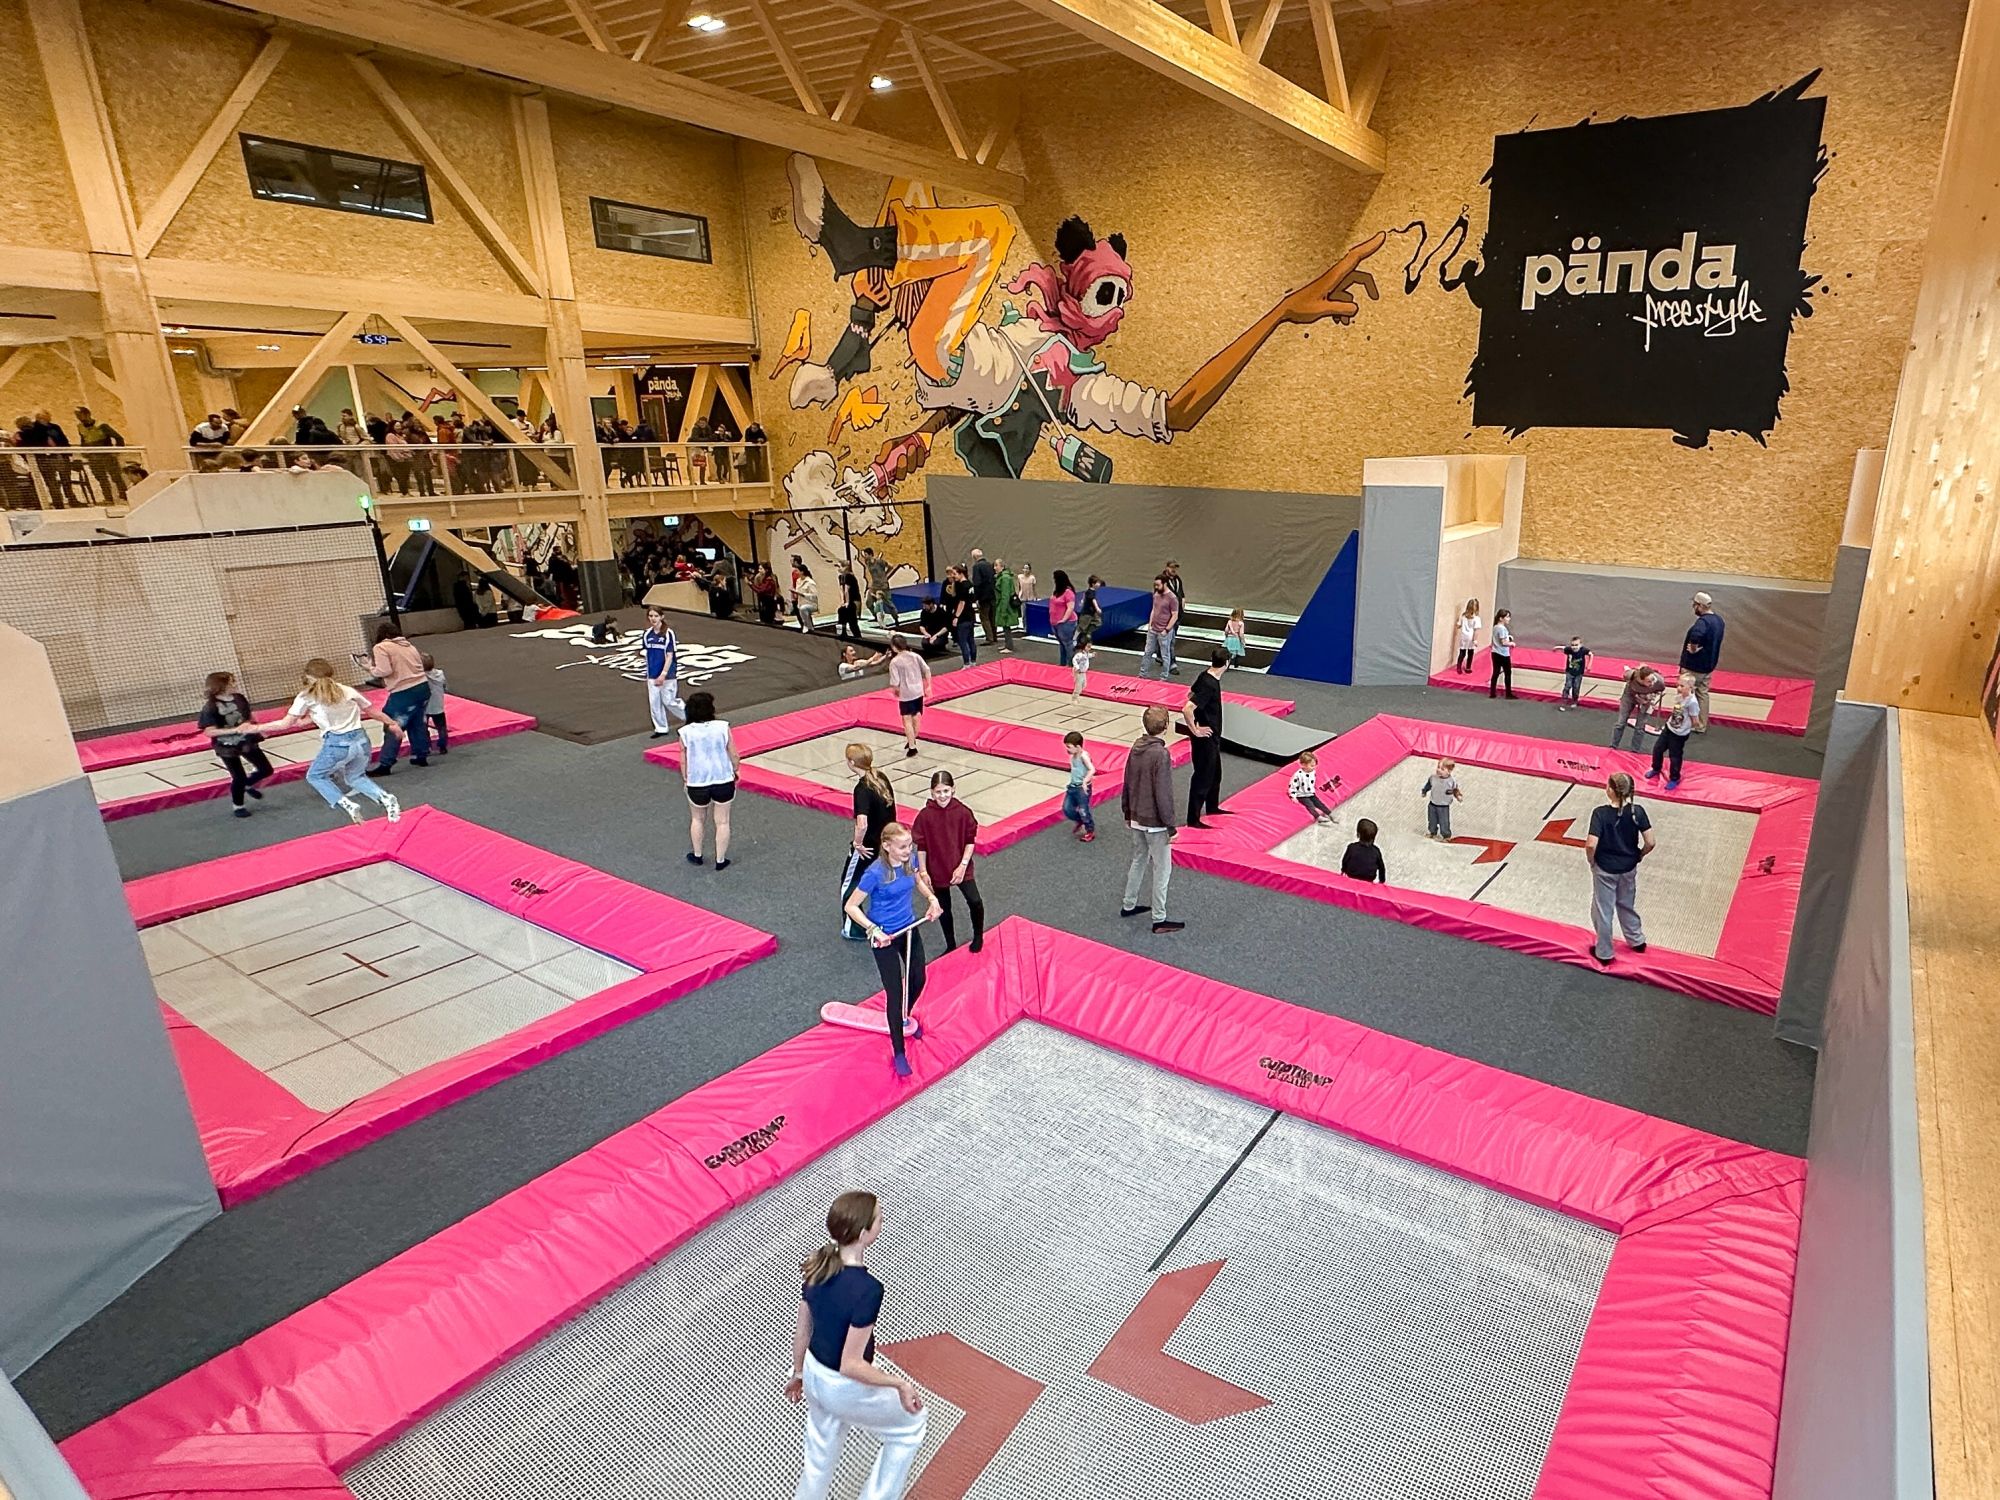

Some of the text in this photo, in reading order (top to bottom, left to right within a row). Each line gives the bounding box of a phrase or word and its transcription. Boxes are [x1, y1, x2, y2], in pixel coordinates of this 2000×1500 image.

[1522, 232, 1737, 310] pända
[1633, 280, 1767, 352] freestyle
[648, 376, 678, 394] pända
